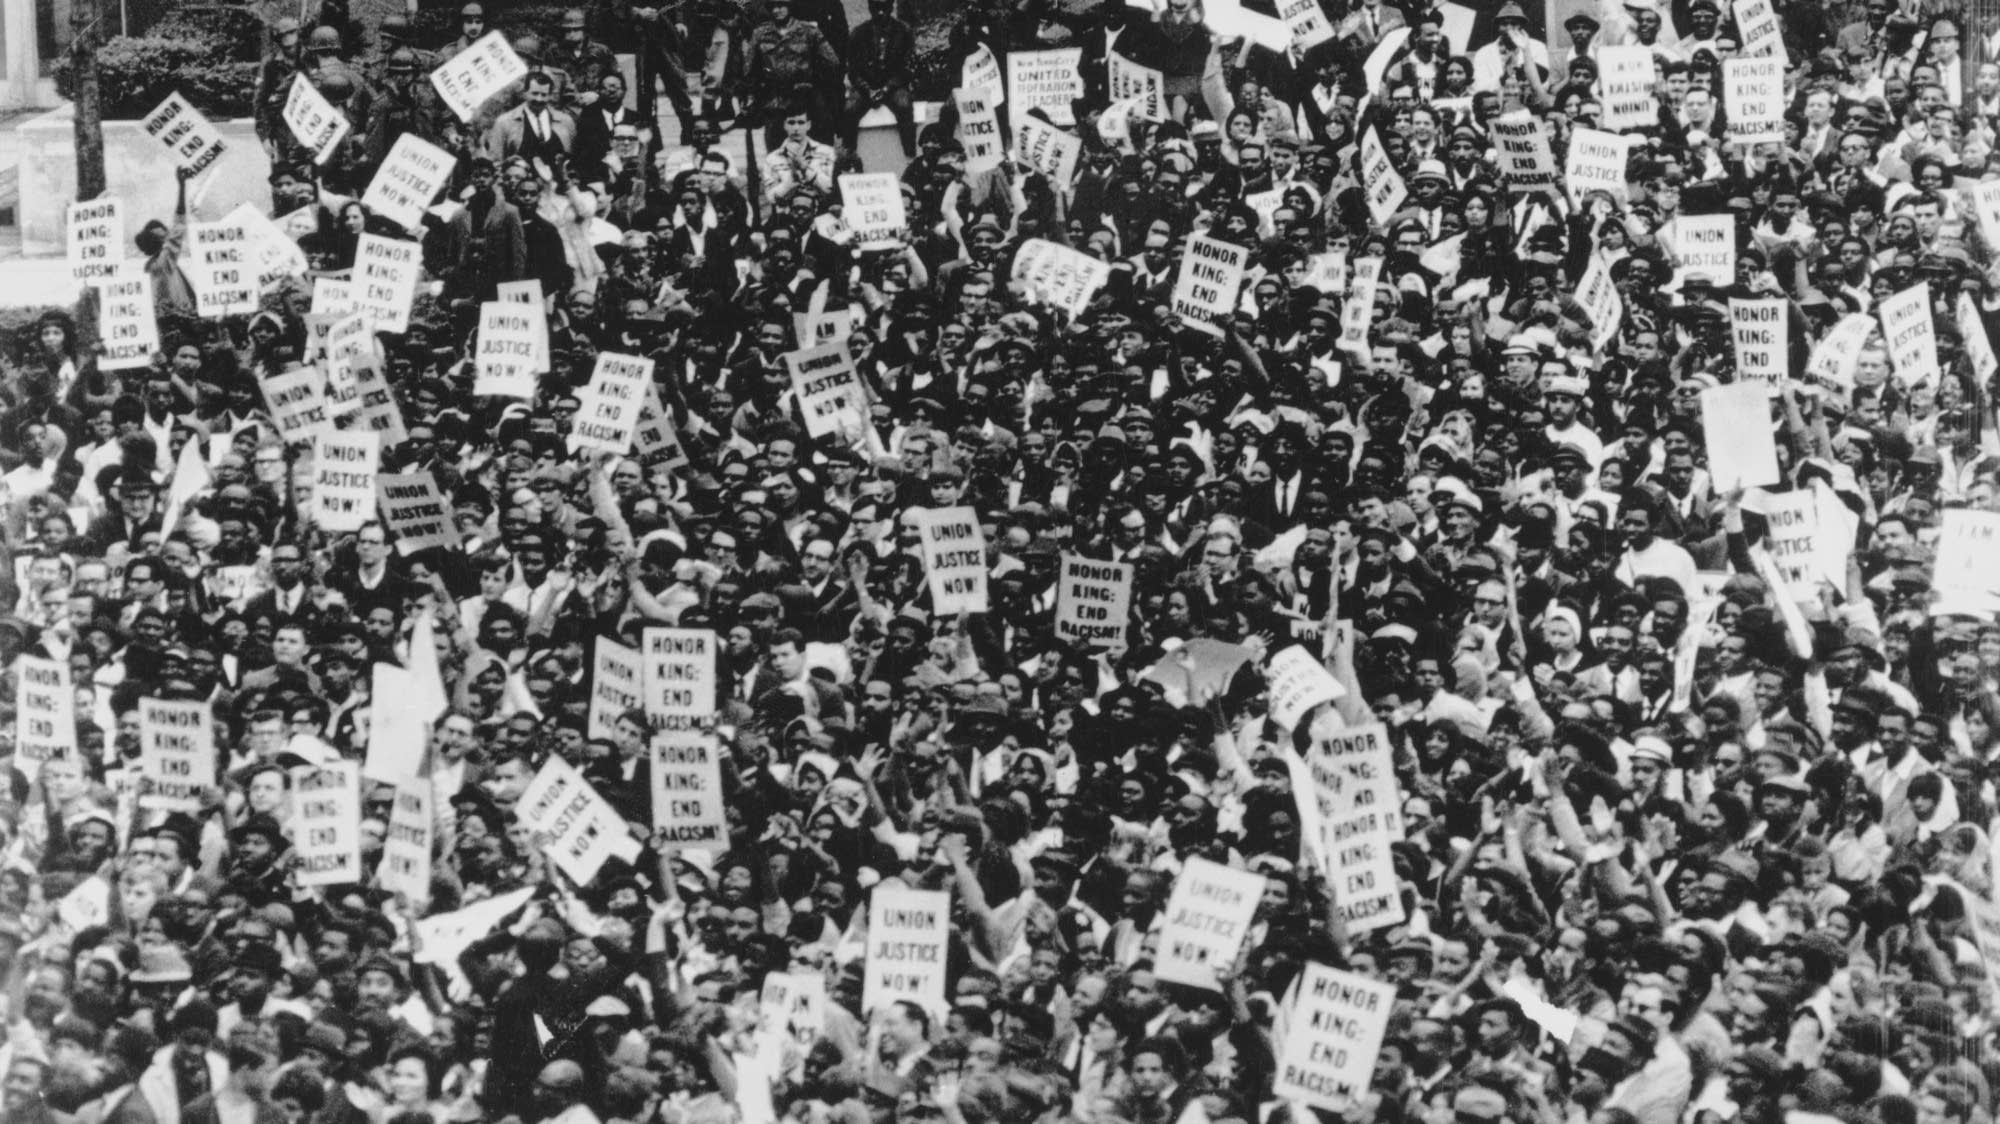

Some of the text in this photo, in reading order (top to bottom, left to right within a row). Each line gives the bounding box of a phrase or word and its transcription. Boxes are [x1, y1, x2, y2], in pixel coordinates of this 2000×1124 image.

[1017, 69, 1071, 82] UNITED
[1733, 65, 1776, 78] HONOR
[1742, 103, 1766, 116] END
[147, 101, 182, 136] HONOR
[163, 120, 195, 148] KING:
[1495, 122, 1537, 136] HONOR
[181, 135, 204, 159] END
[1503, 140, 1539, 154] KING:
[1581, 143, 1619, 158] UNION
[401, 148, 440, 172] UNION
[1513, 158, 1537, 170] END
[388, 165, 433, 195] JUSTICE
[1573, 163, 1620, 182] JUSTICE
[74, 205, 116, 222] HONOR
[864, 209, 889, 223] END
[199, 227, 244, 243] HONOR
[1686, 229, 1725, 243] UNION
[81, 246, 106, 260] END
[365, 243, 411, 262] HONOR
[1193, 242, 1237, 265] HONOR
[1683, 252, 1730, 266] JUSTICE
[213, 271, 239, 285] END
[1193, 264, 1229, 285] KING:
[323, 287, 347, 300] HON
[368, 285, 394, 301] END
[1192, 284, 1217, 304] END
[1177, 301, 1221, 325] RACISM
[1735, 307, 1779, 322] HONOR
[1888, 302, 1920, 326] UNION
[113, 324, 138, 339] END
[489, 316, 530, 331] UNION
[1740, 330, 1775, 345] KING:
[1893, 322, 1927, 348] JUSTICE
[482, 340, 531, 357] JUSTICE
[799, 353, 842, 374] UNION
[1744, 352, 1769, 367] END
[603, 360, 645, 379] HONOR
[804, 371, 853, 397] JUSTICE
[596, 405, 621, 421] END
[579, 425, 629, 444] RACISM!
[323, 445, 366, 461] UNION
[318, 471, 370, 489] JUSTICE
[385, 485, 428, 499] UNION
[392, 504, 444, 521] JUSTICE
[401, 522, 444, 538] NOW!
[932, 524, 972, 541] UNION
[934, 551, 980, 569] JUSTICE
[1069, 563, 1122, 582] HONOR
[1073, 585, 1115, 602] KING:
[1077, 606, 1107, 620] END
[1061, 621, 1120, 640] RACISM!
[653, 637, 704, 654] HONOR
[657, 664, 700, 681] KING:
[663, 689, 691, 706] END
[148, 708, 201, 726] HONOR
[31, 718, 50, 738] END
[1321, 734, 1376, 756] HONOR
[658, 747, 708, 763] HONOR
[162, 758, 190, 775] END
[664, 773, 706, 791] KING:
[529, 776, 566, 821] UNION
[672, 800, 701, 817] END
[1335, 813, 1374, 841] HONOR
[1348, 871, 1374, 894] END
[1190, 880, 1241, 904] UNION
[884, 909, 936, 929] UNION
[1172, 908, 1237, 938] JUSTICE
[875, 942, 939, 963] JUSTICE
[1313, 977, 1379, 1012] HONOR
[1311, 1010, 1366, 1041] KING:
[1310, 1041, 1347, 1069] END
[1284, 1065, 1358, 1098] RACISM!
